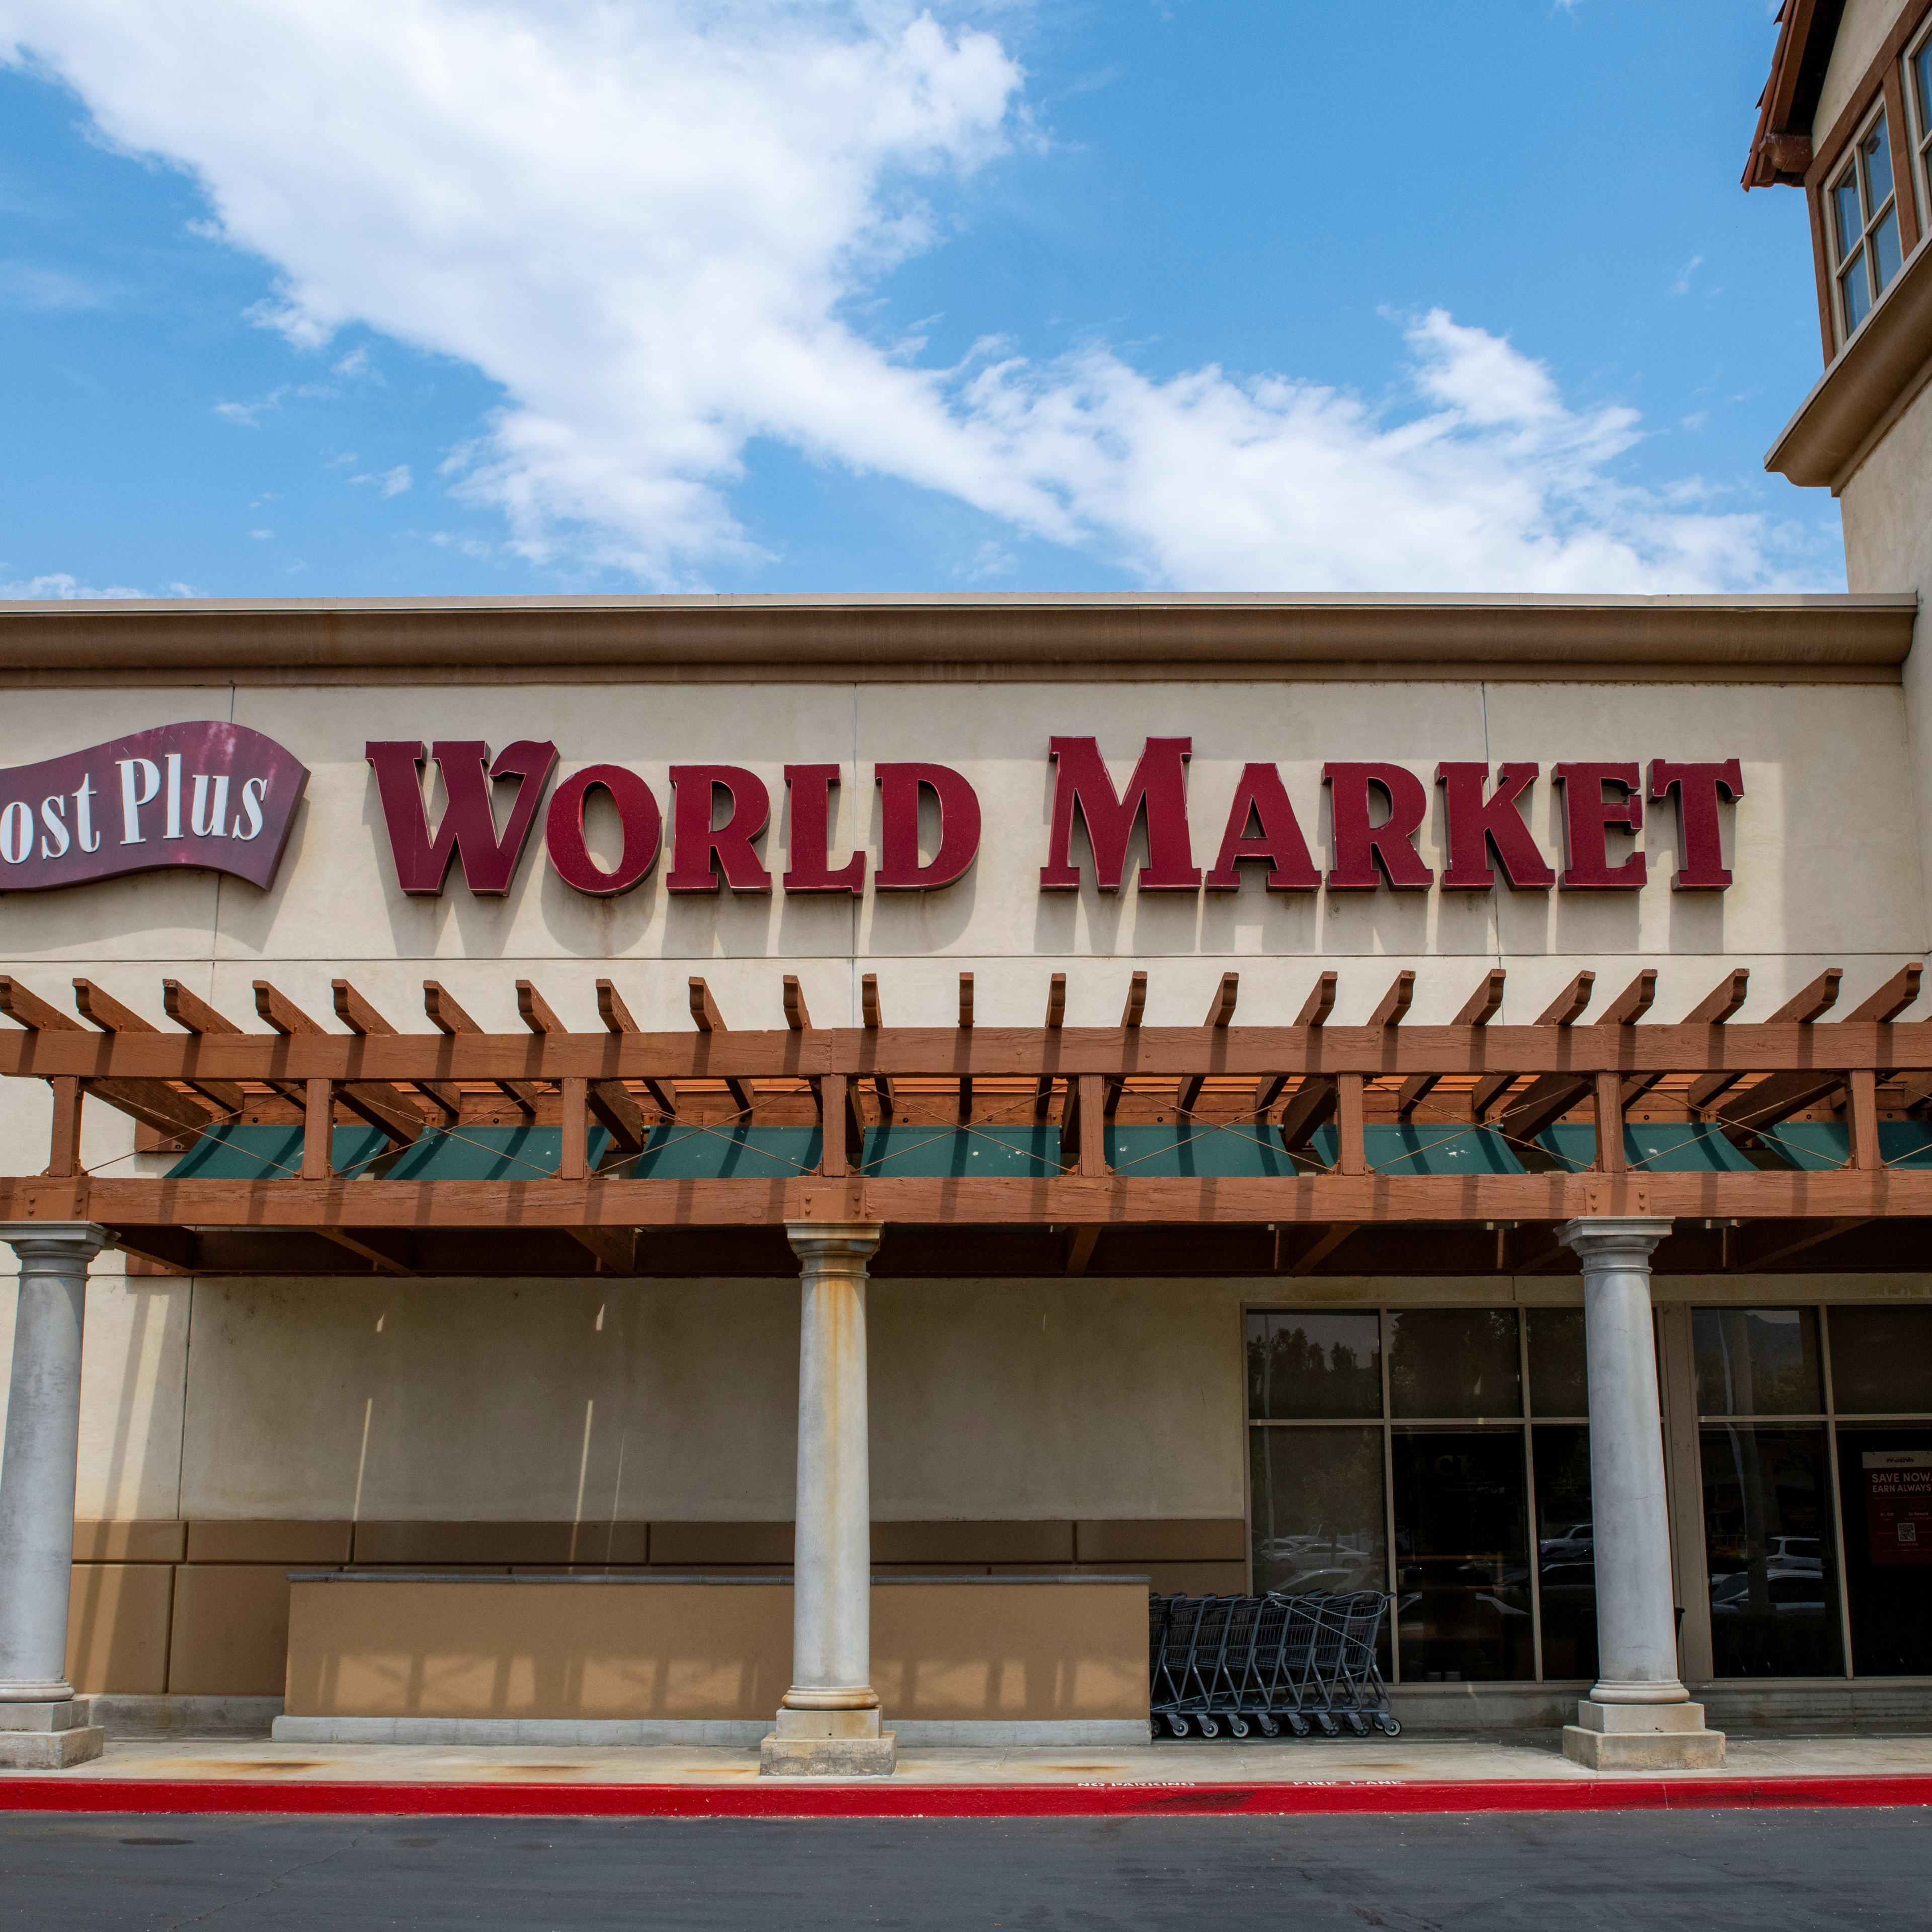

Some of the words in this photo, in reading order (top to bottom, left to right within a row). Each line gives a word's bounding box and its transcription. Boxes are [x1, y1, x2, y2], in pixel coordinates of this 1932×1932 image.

[115, 753, 268, 845] Plus
[365, 740, 981, 898] WORLD
[1039, 736, 1744, 892] MARKET
[1871, 1473, 1900, 1483] SAVE
[1872, 1485, 1895, 1493] EARN
